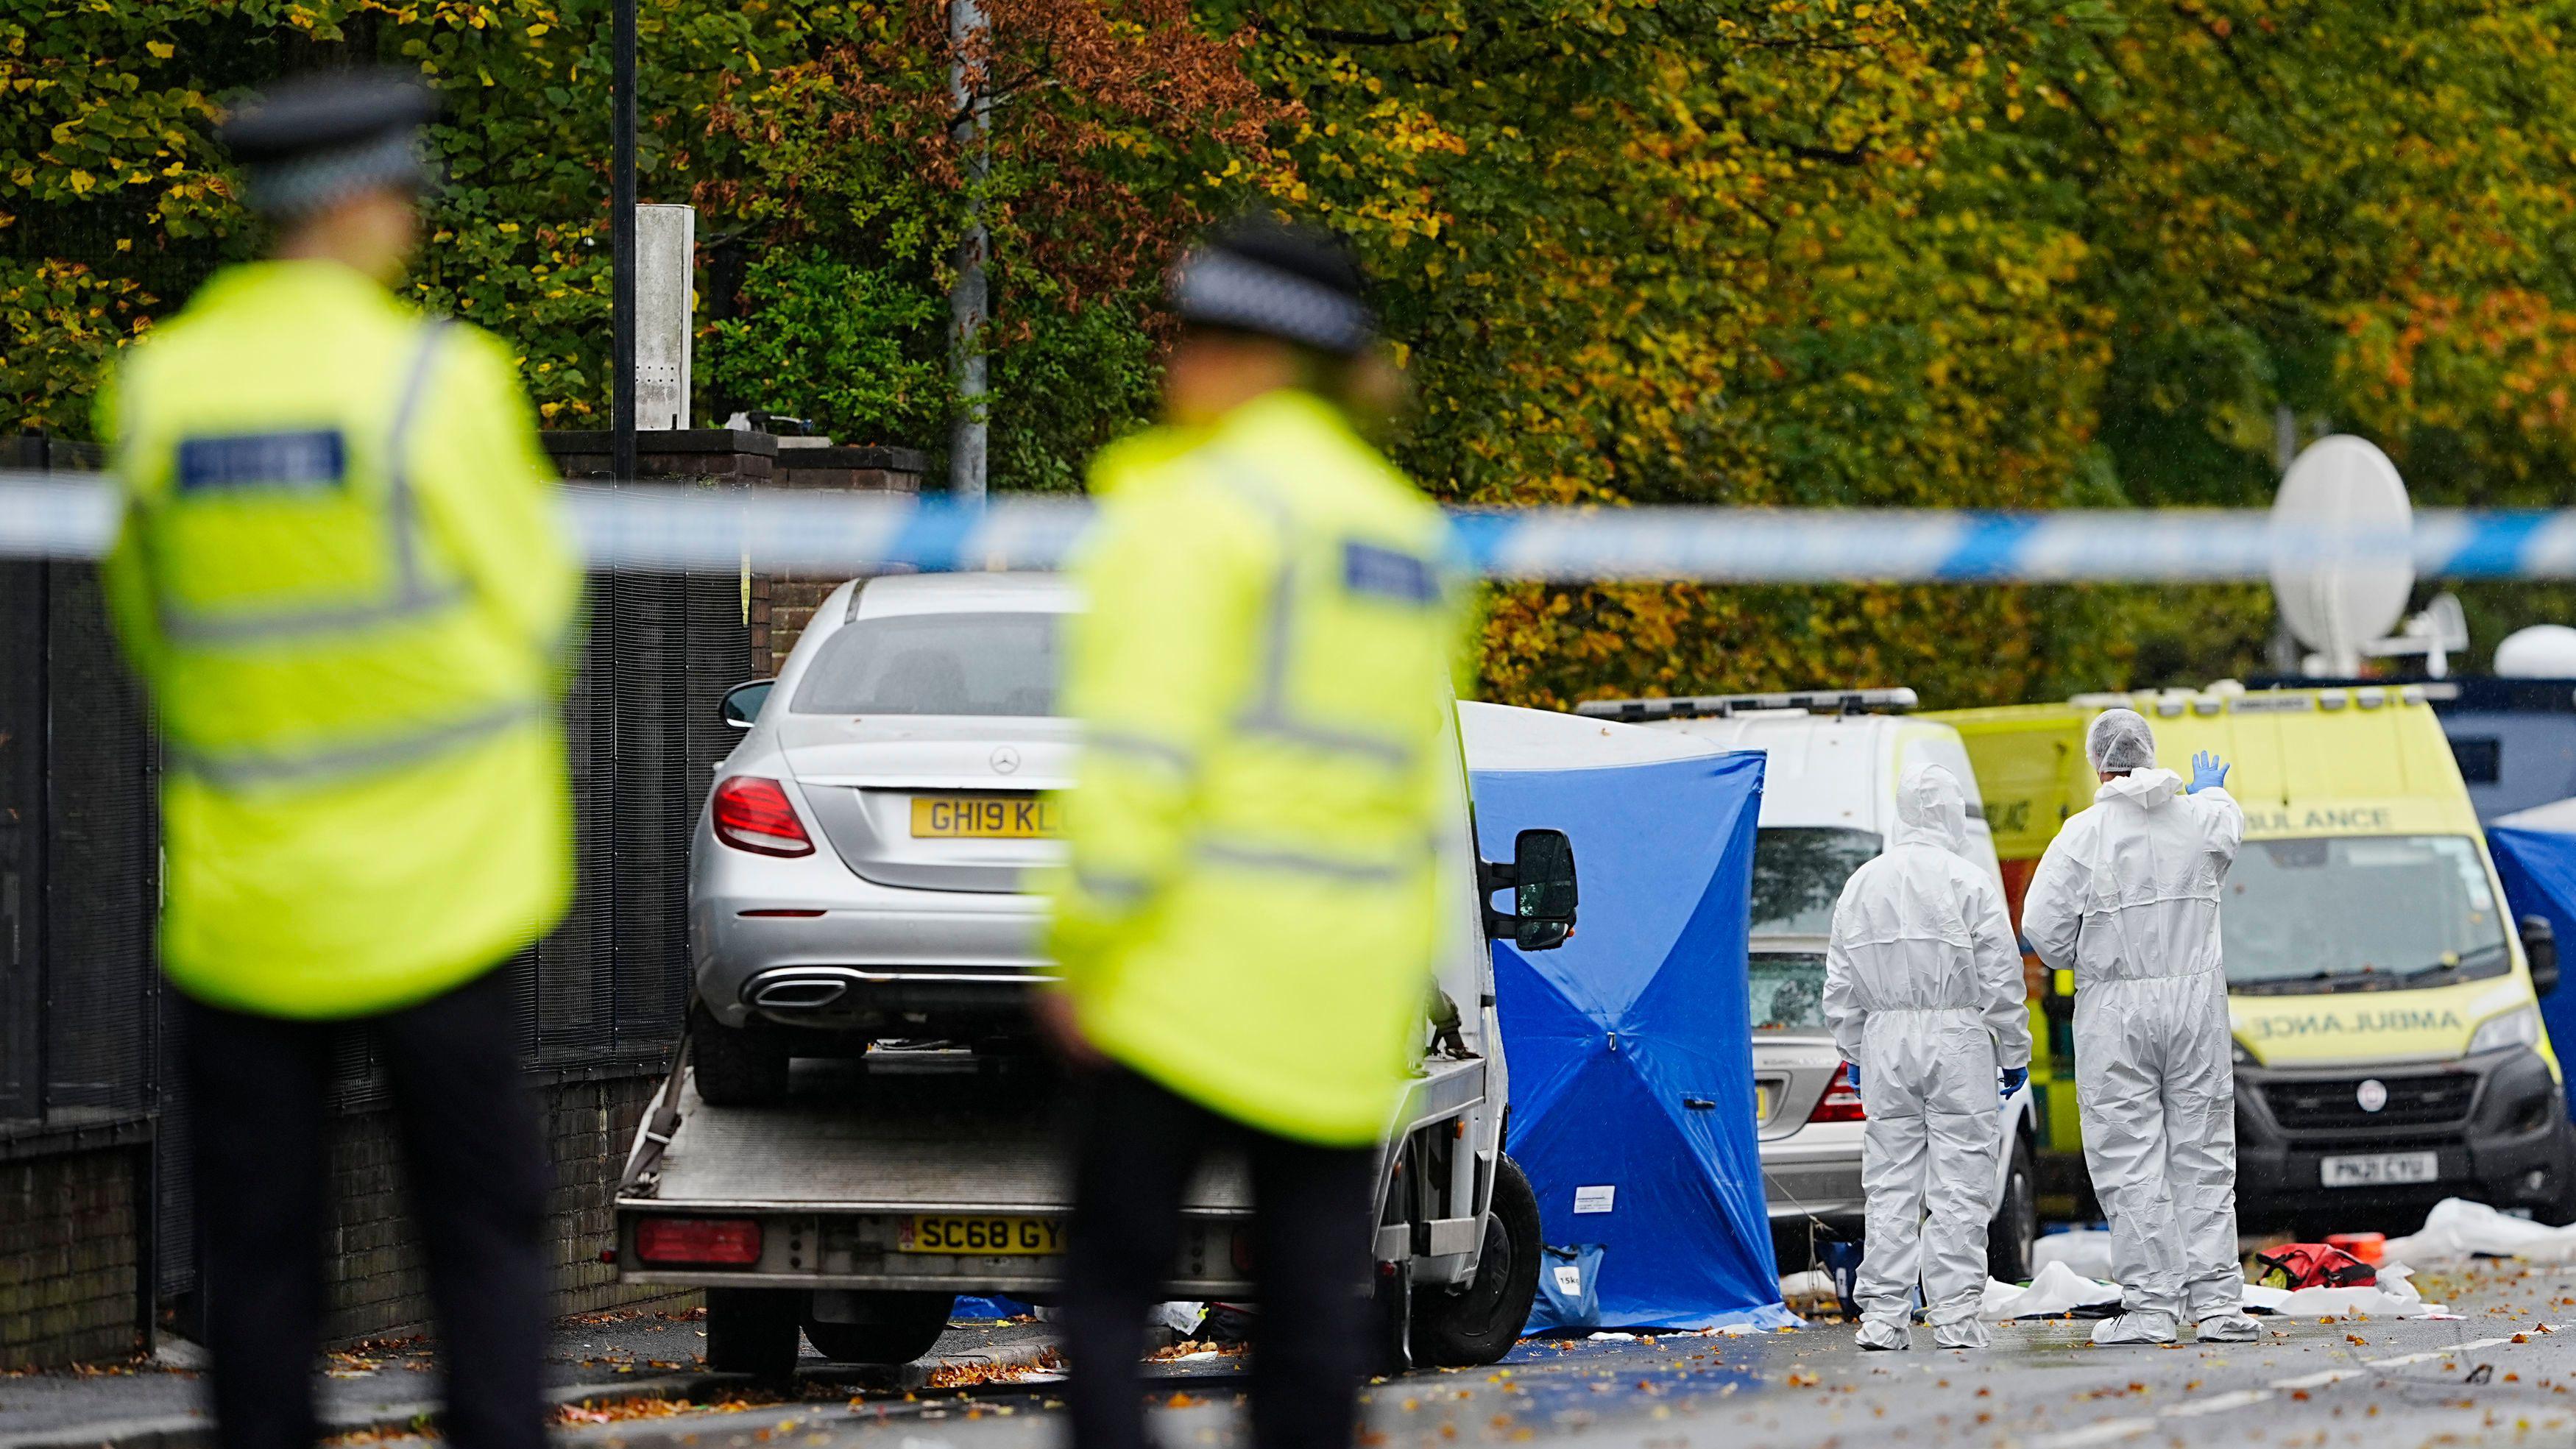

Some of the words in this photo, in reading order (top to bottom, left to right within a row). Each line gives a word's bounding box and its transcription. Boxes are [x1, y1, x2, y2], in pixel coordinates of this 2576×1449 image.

[932, 801, 1004, 831] GH19
[1014, 802, 1075, 831] KL
[2245, 807, 2391, 830] BULANCE
[922, 1219, 1008, 1248] SC68
[1019, 1219, 1063, 1249] GY
